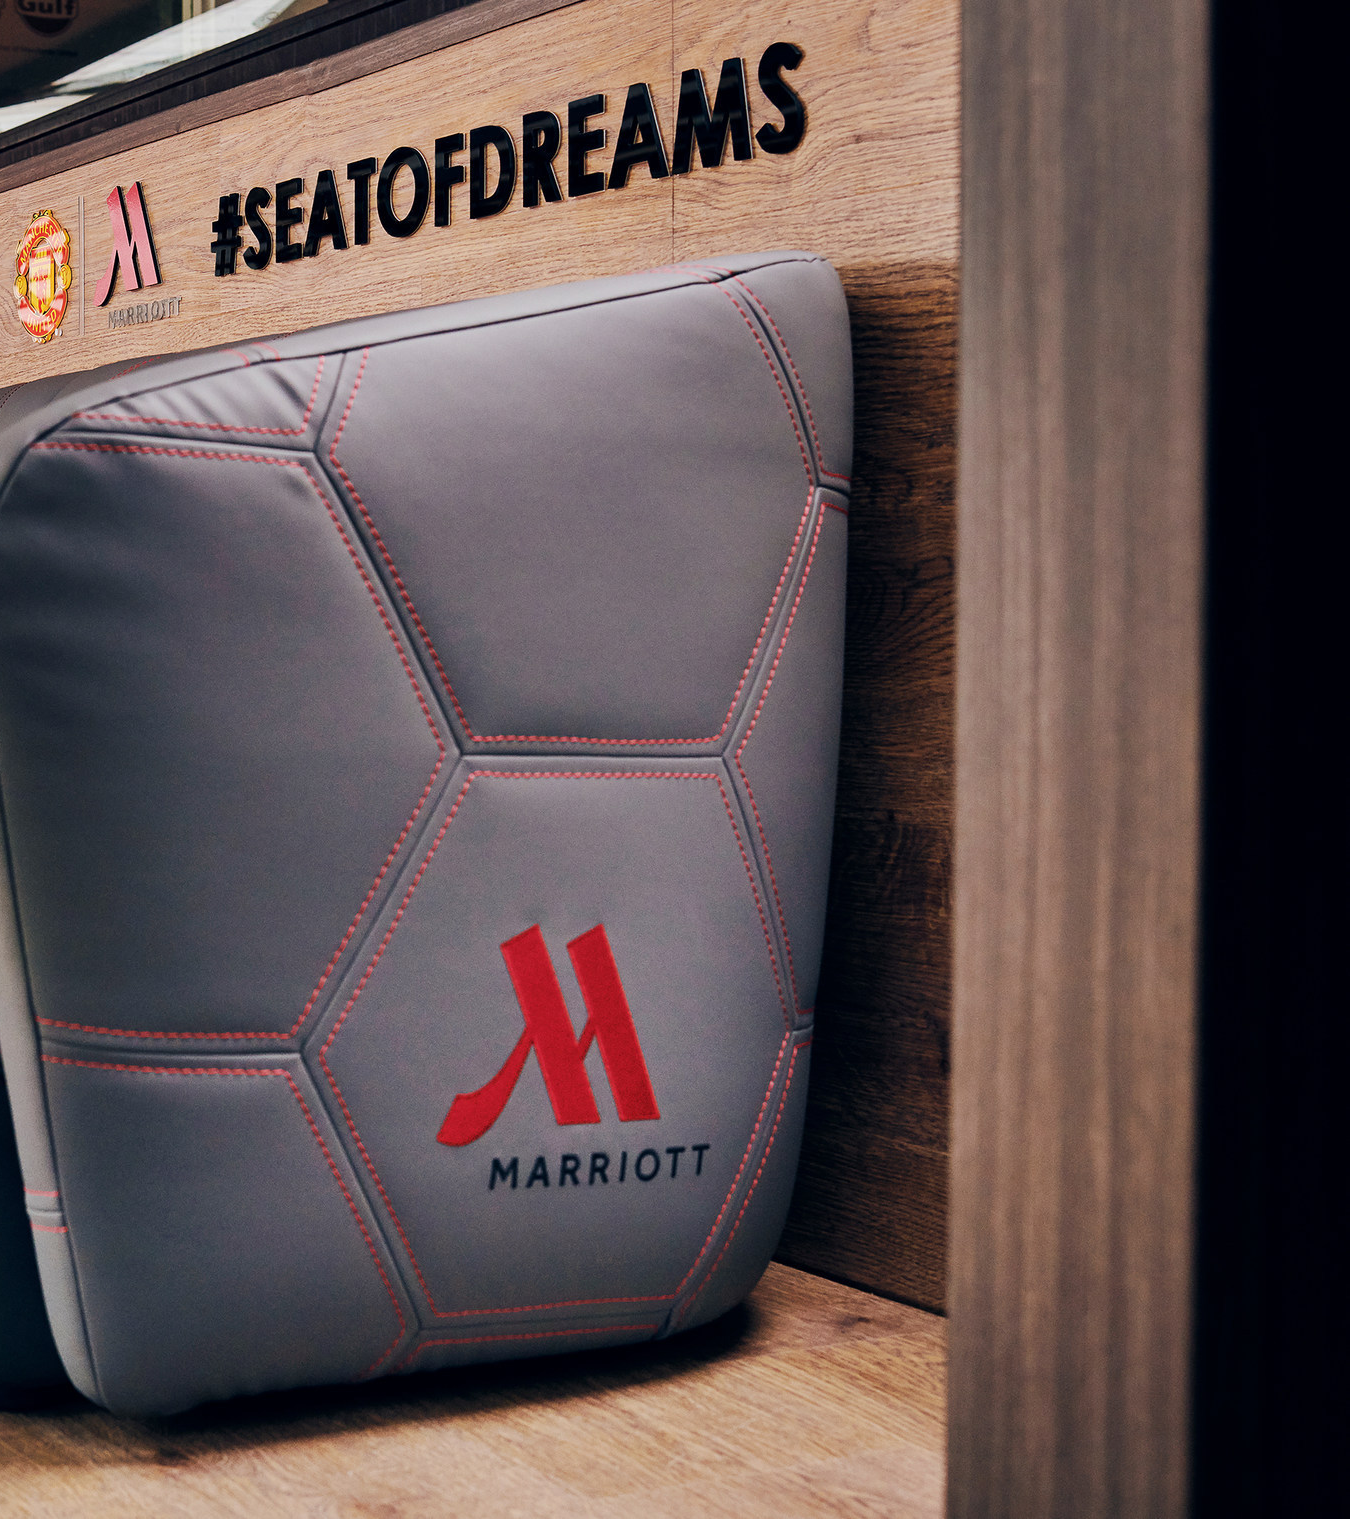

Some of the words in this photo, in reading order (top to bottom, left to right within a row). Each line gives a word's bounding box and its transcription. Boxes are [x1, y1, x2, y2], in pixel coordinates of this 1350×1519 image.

[211, 41, 806, 277] #SEATOFDREAMS
[108, 296, 182, 329] MARRIOTT
[488, 1143, 711, 1191] MARRIOTT
